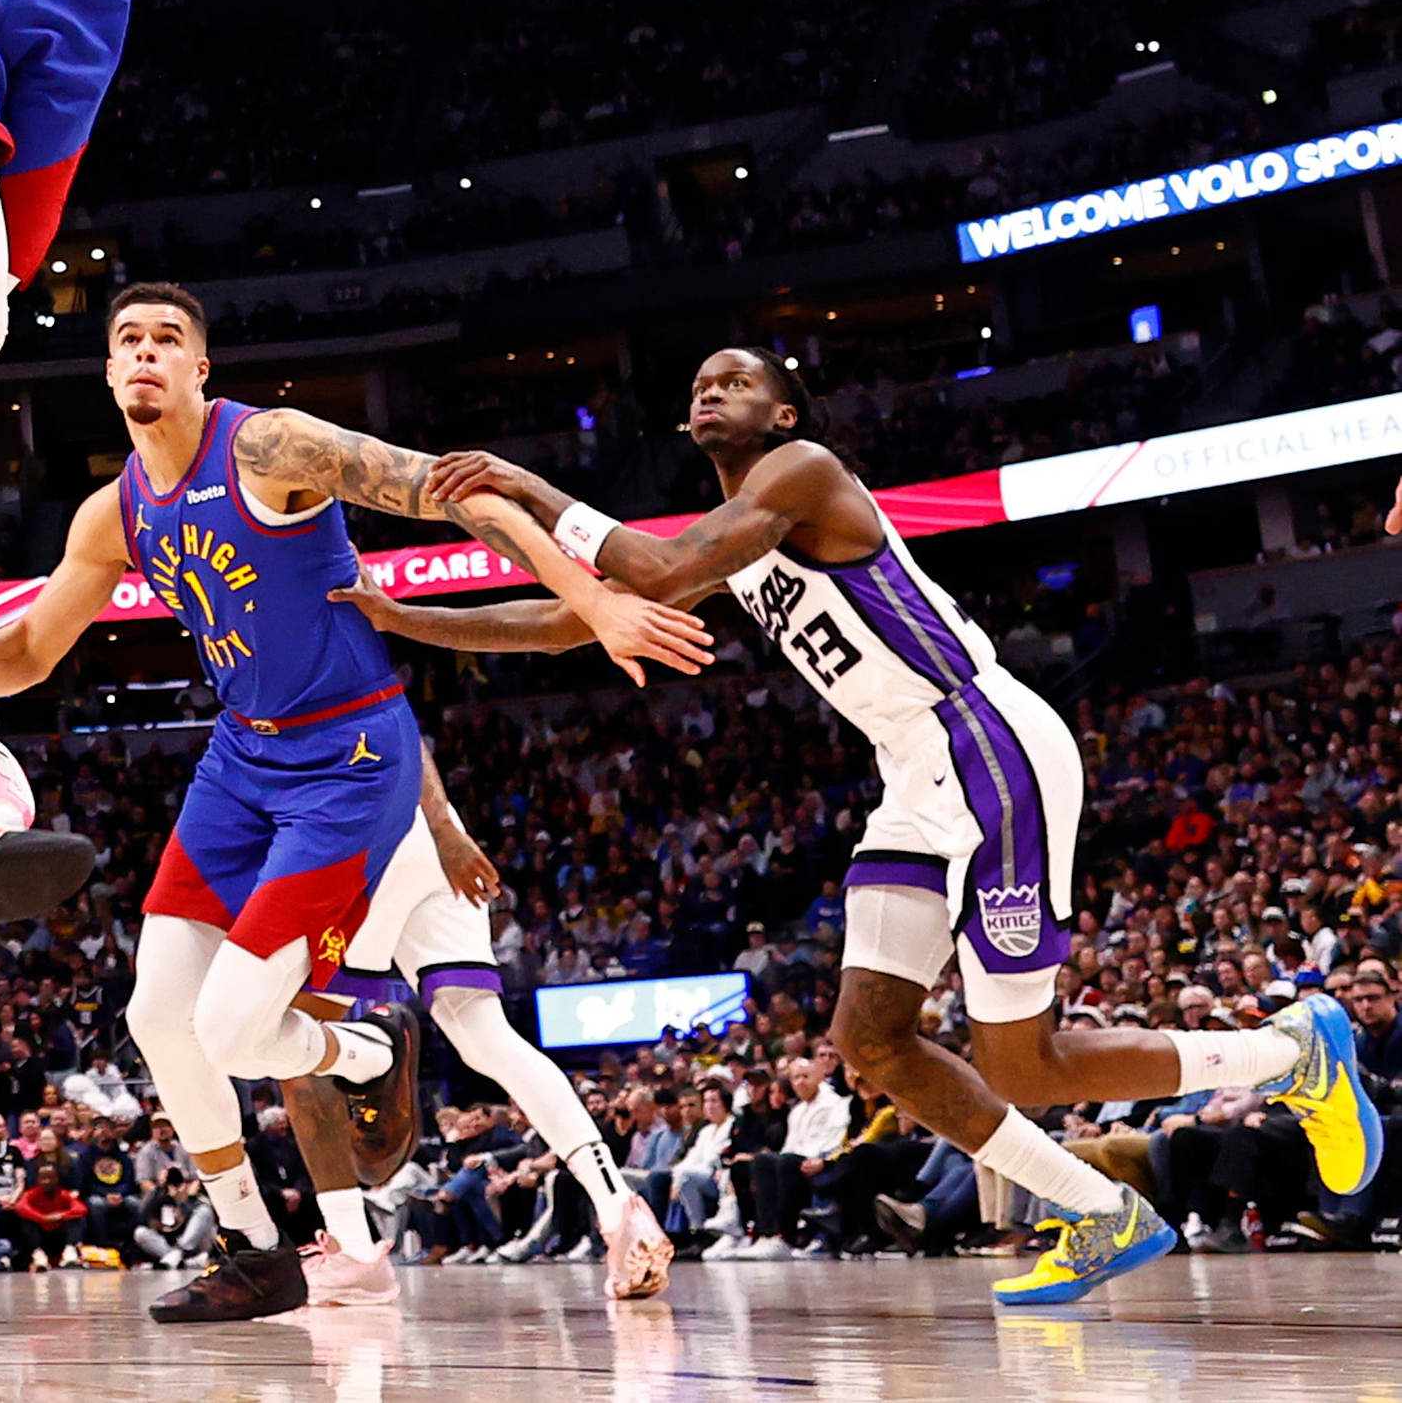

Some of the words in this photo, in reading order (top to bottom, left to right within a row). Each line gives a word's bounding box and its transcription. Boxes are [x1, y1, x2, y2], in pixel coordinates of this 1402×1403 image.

[968, 178, 1169, 258] WELCOME
[1170, 152, 1288, 210] VOLO
[1153, 431, 1314, 478] OFFICIAL
[186, 485, 226, 505] ibotta
[151, 535, 184, 610] MILE
[182, 523, 258, 591] HIGH
[404, 550, 490, 585] CARE
[182, 570, 215, 627] 1
